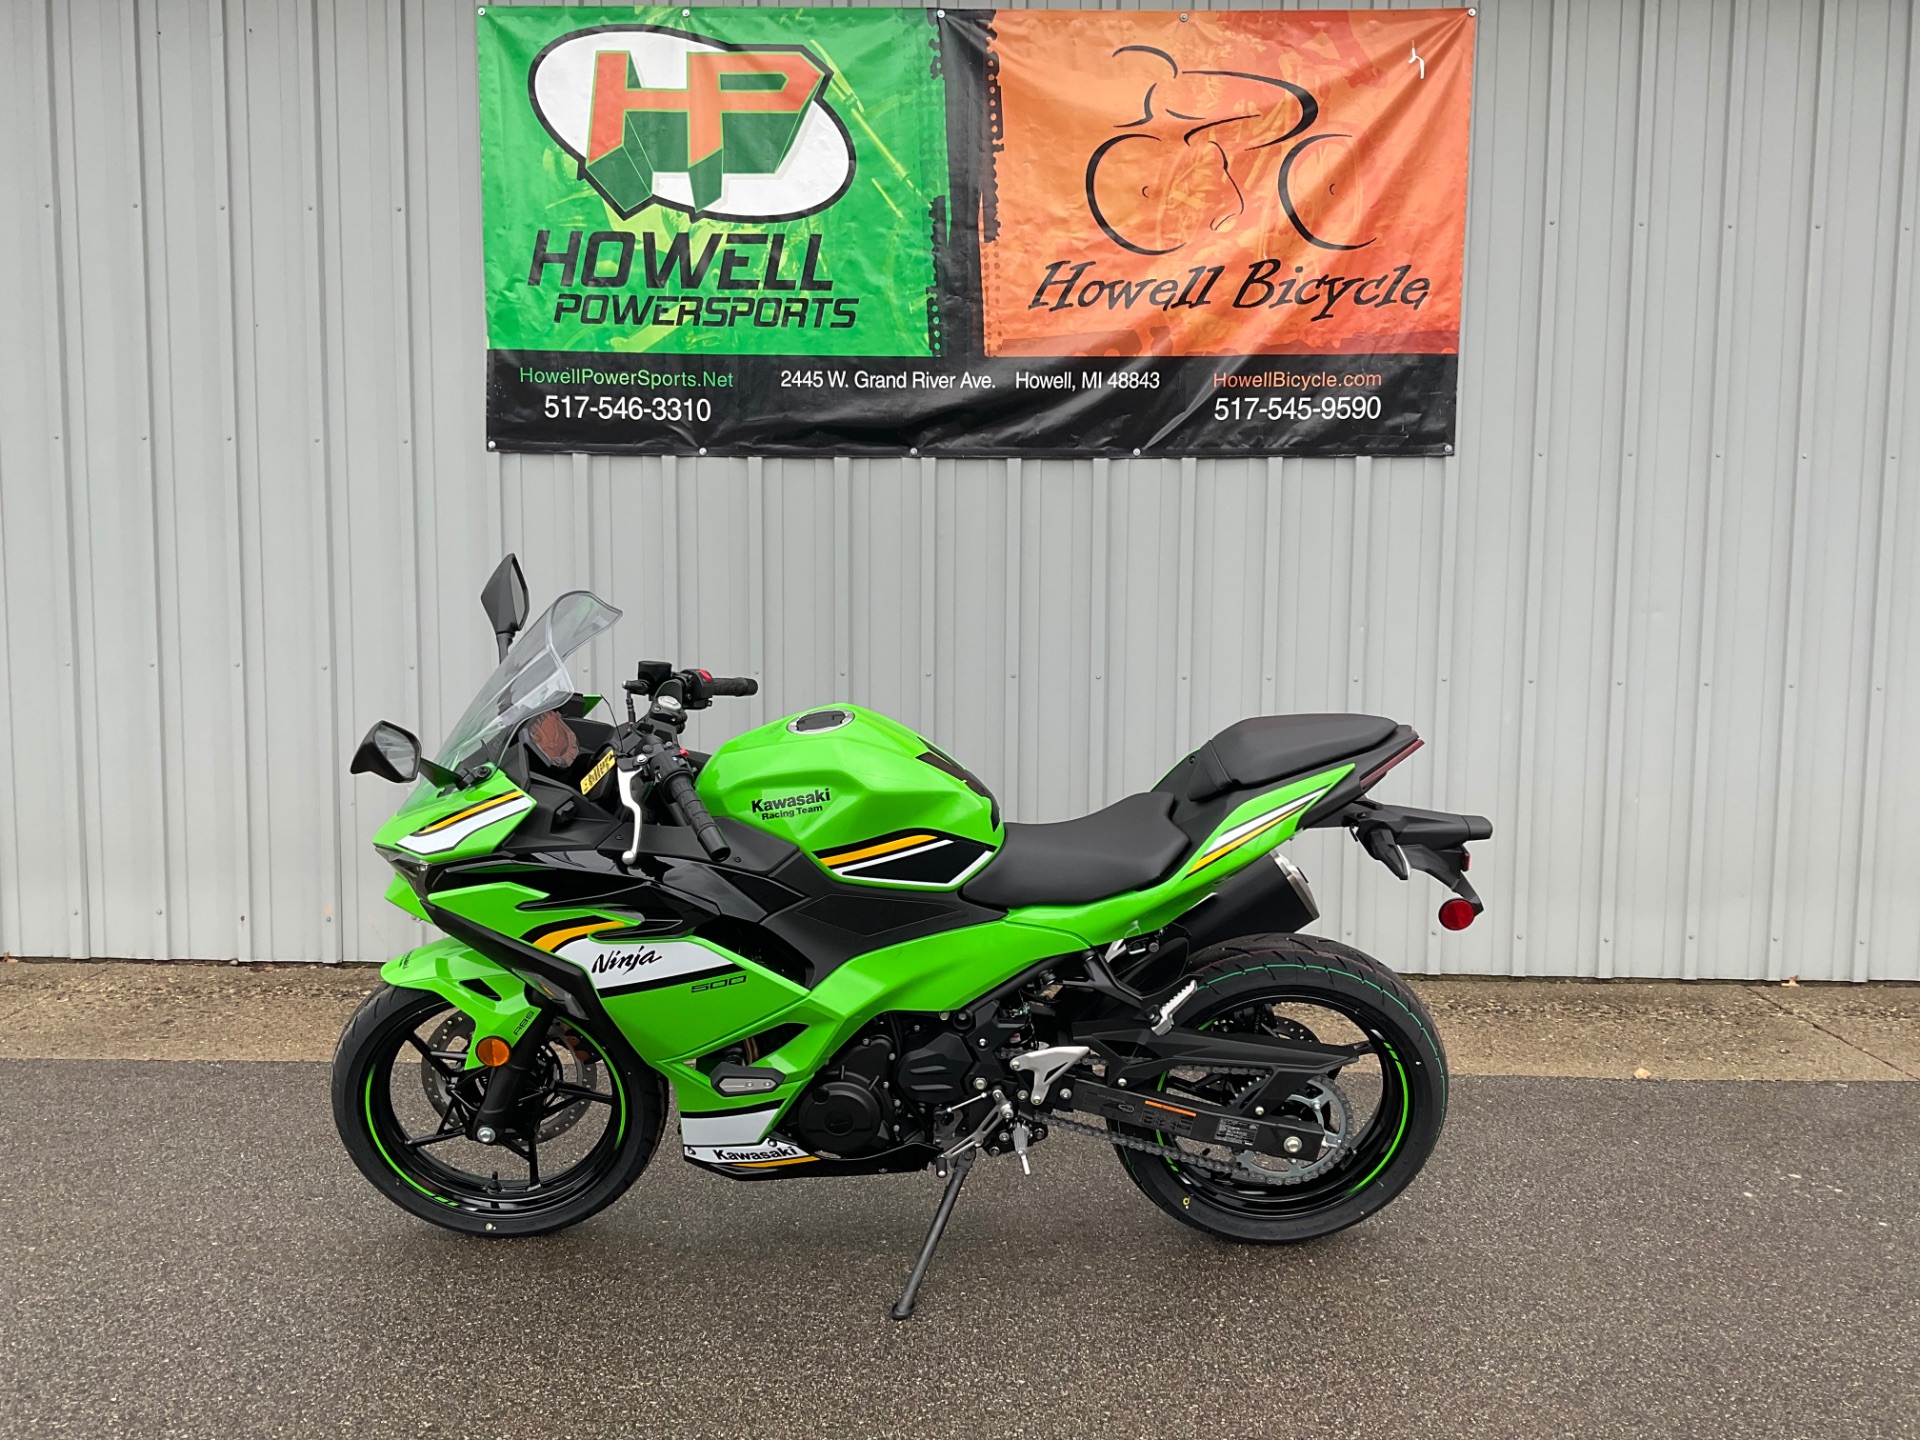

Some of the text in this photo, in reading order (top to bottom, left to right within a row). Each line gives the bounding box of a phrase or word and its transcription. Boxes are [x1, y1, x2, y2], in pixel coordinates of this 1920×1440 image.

[527, 229, 833, 291] HOWELL
[1028, 258, 1431, 322] Howell Bicycle
[553, 294, 859, 329] POWERSPORTS
[519, 367, 734, 391] HowellPowerSports.Net
[780, 370, 996, 389] 2445 W. Grand River Ave.
[1015, 371, 1160, 391] Howell, MI 48843
[1213, 371, 1382, 391] HowellBicycle.com
[544, 395, 712, 422] 517-546-3310
[1213, 396, 1382, 421] 517-545-9590
[751, 788, 831, 813] Kawasaki
[762, 805, 823, 820] Racing Team
[591, 945, 663, 976] Ninja
[691, 975, 747, 993] 500
[713, 1146, 798, 1160] Kawasaki
